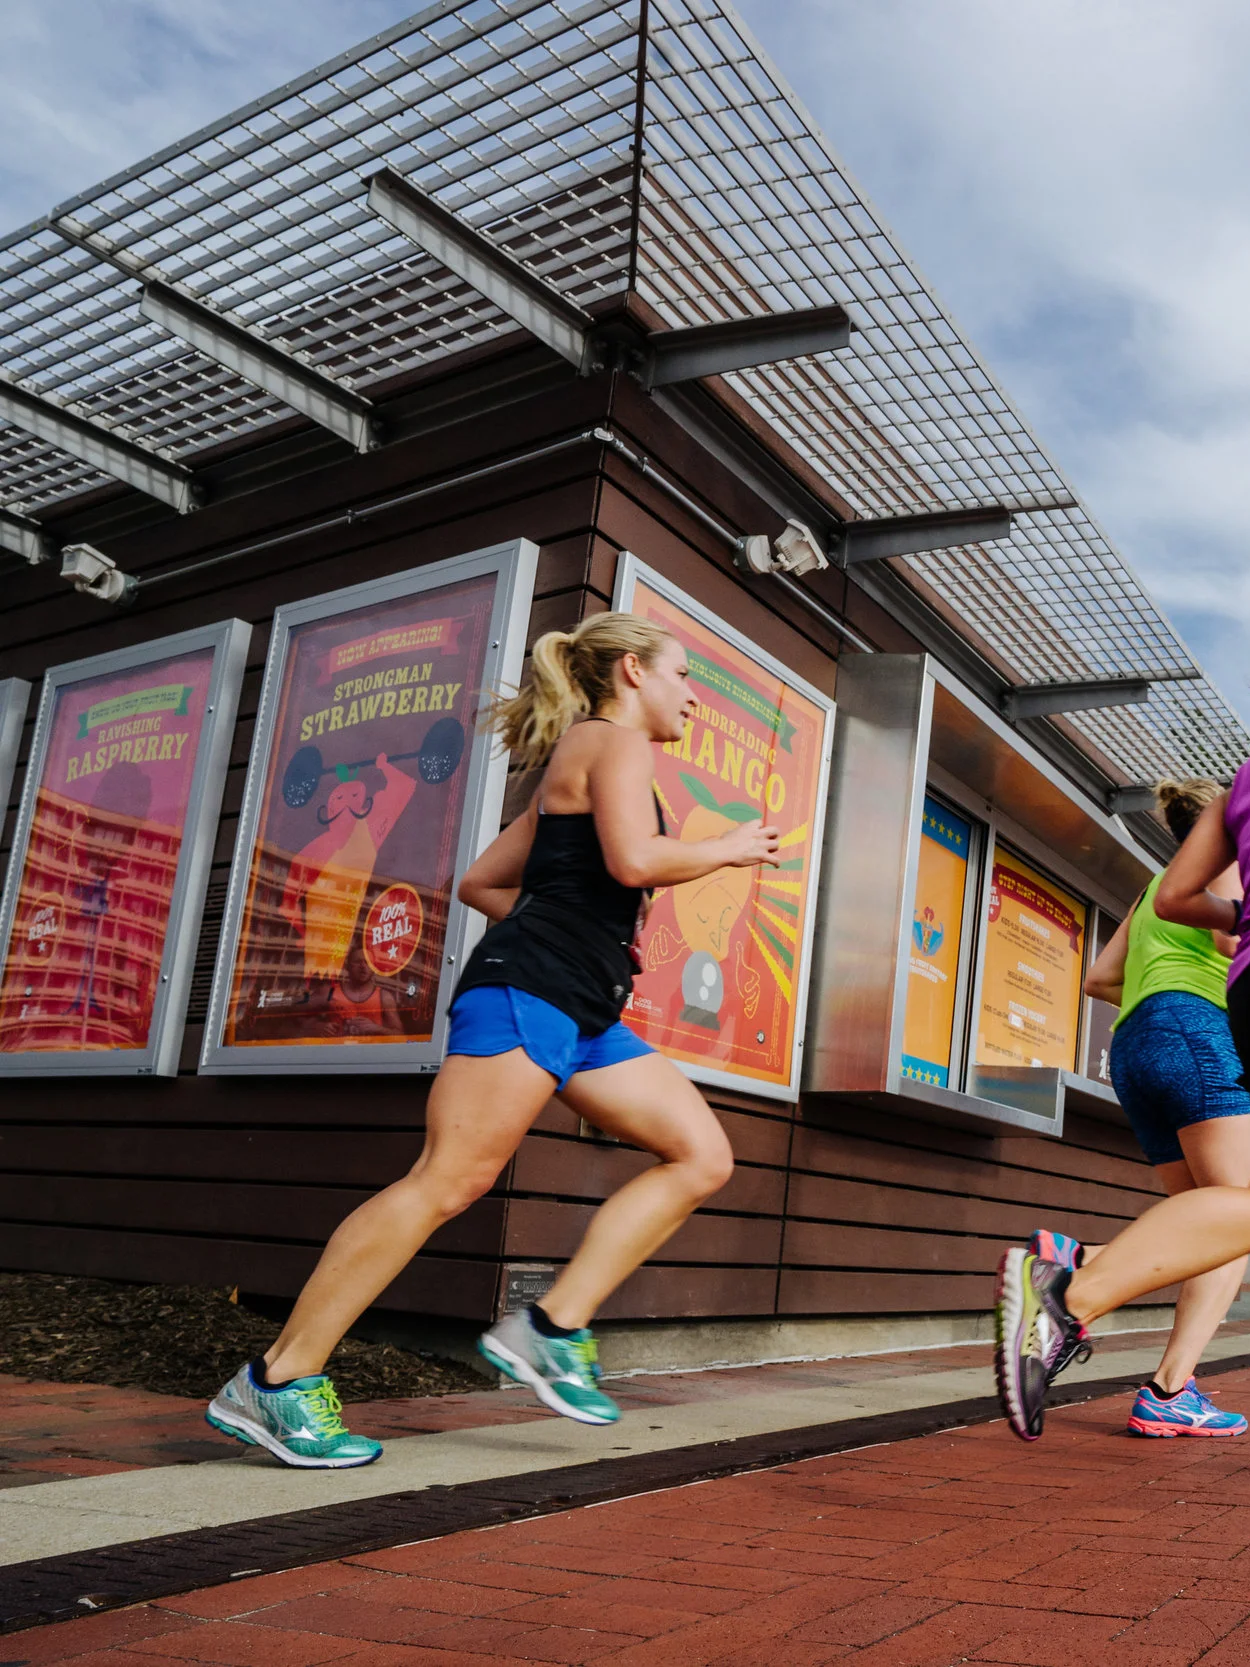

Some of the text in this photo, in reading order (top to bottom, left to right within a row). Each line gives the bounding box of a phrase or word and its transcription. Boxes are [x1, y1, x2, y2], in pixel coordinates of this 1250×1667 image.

[337, 625, 443, 665] NOW APPEARING!
[333, 662, 433, 701] STRONGMAN
[300, 683, 463, 741] STRAWBERRY
[98, 716, 162, 744] RAVISHING
[662, 719, 786, 813] MANGO
[998, 873, 1016, 890] STEP
[1016, 882, 1036, 902] RIGHT
[378, 901, 407, 923] 100%
[28, 917, 58, 941] REAL
[371, 916, 413, 946] REAL
